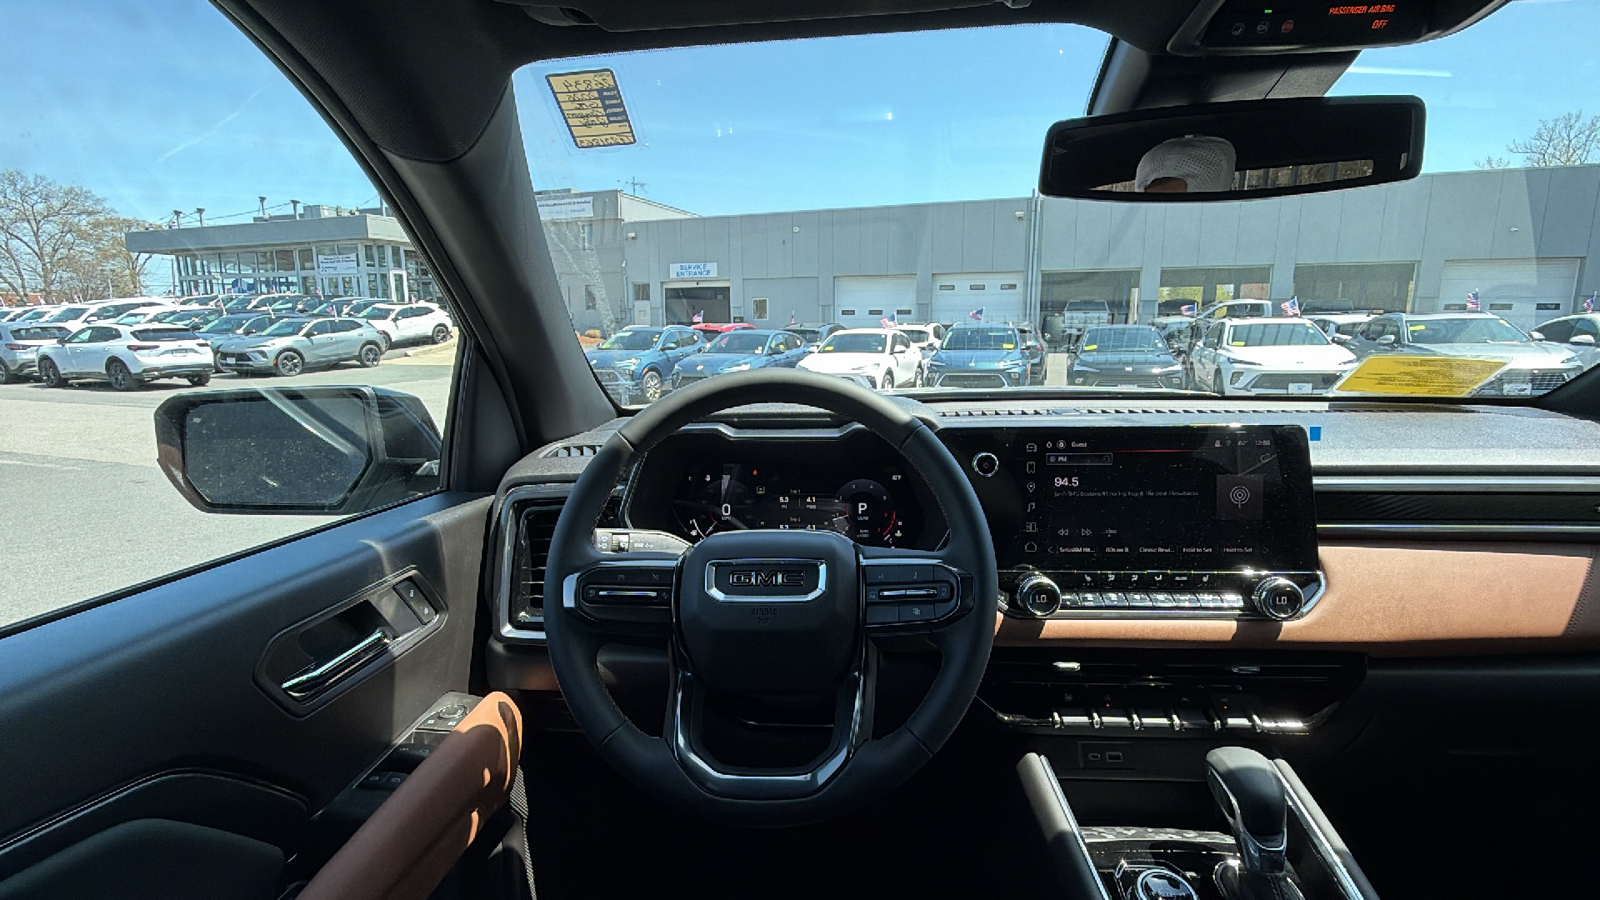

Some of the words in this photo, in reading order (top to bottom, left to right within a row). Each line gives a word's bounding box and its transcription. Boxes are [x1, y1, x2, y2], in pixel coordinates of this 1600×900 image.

[1328, 5, 1368, 15] PASSENGER
[1371, 19, 1389, 29] OFF
[1054, 477, 1079, 487] 94.5
[722, 503, 731, 516] 0
[858, 502, 868, 515] P
[729, 570, 805, 587] GMC
[1035, 594, 1047, 603] LO
[1276, 596, 1288, 604] LO
